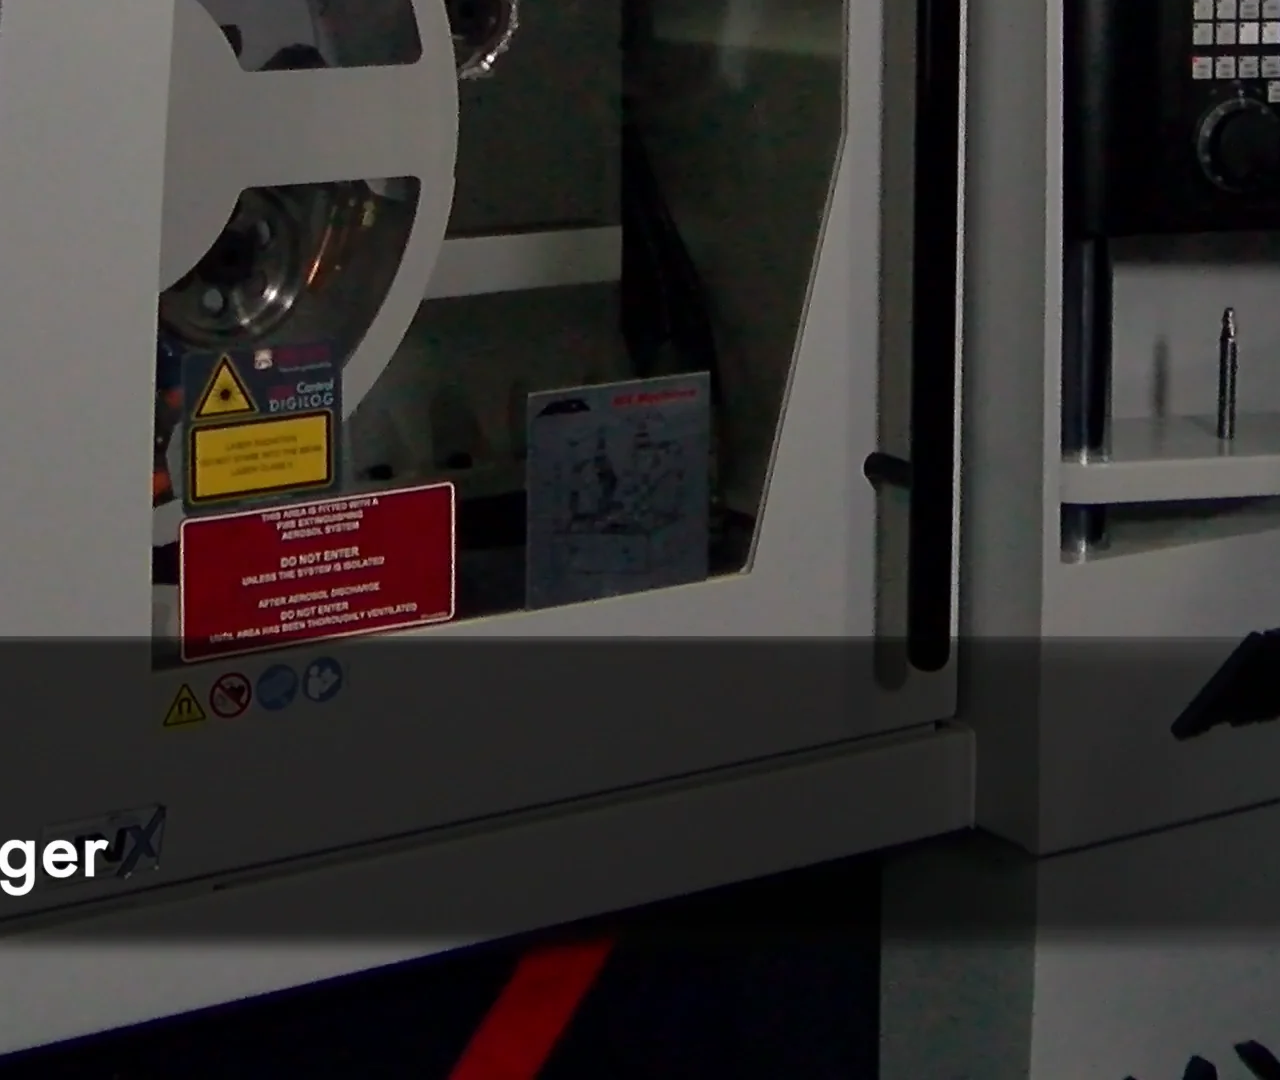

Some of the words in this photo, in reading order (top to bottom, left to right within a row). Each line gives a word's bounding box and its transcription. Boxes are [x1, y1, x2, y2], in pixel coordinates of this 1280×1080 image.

[283, 507, 308, 519] AREA
[372, 497, 379, 506] A
[281, 526, 324, 540] AEROSOL
[324, 520, 360, 535] SYSTEM
[280, 555, 298, 569] DO
[298, 551, 322, 565] NOT
[323, 545, 359, 562] ENTER
[241, 571, 277, 586] UNLESS
[278, 569, 296, 581] THE
[297, 563, 332, 578] SYSTEM
[333, 561, 342, 572] IS
[343, 556, 385, 571] ISOLATED
[258, 595, 286, 609] AFTER
[287, 590, 329, 604] AEROSOL
[236, 627, 261, 639] AREA
[262, 624, 280, 635] HAS
[281, 620, 306, 633] BEEN
[366, 602, 419, 619] VENTILATED
[280, 610, 295, 621] DO
[296, 606, 317, 618] NOT
[317, 601, 349, 616] ENTER
